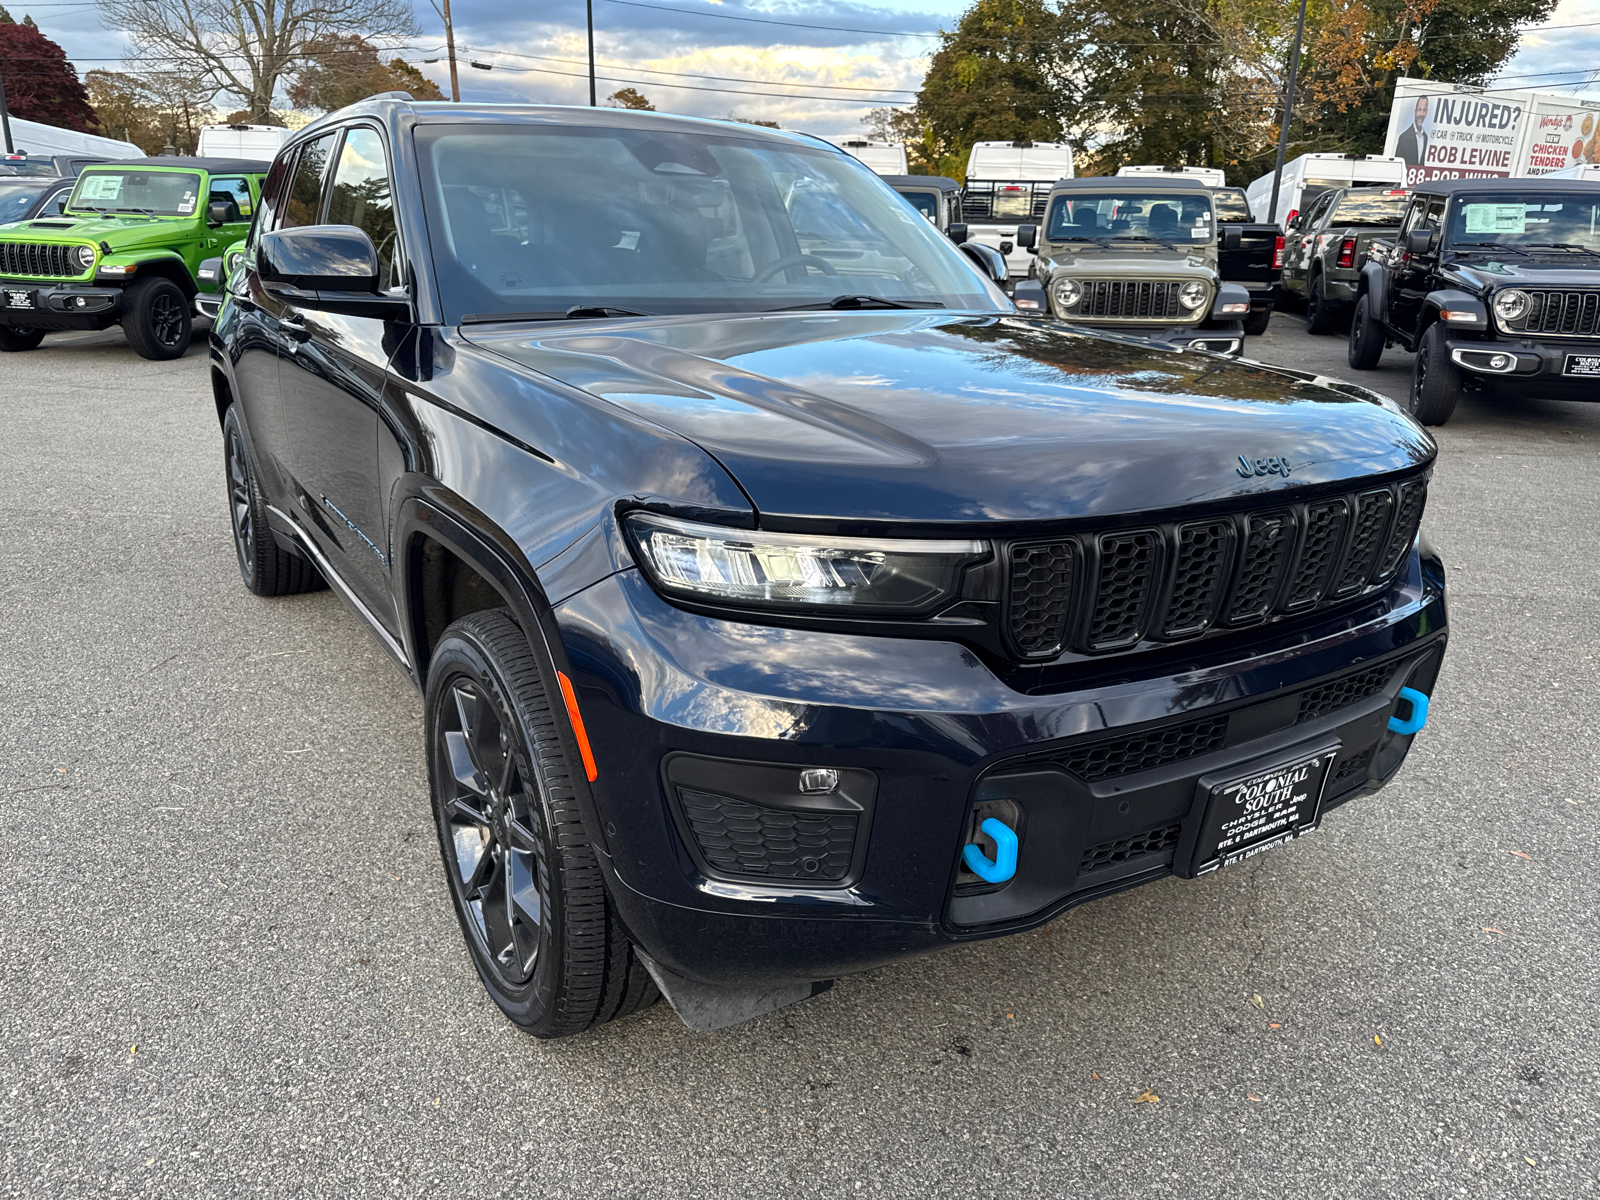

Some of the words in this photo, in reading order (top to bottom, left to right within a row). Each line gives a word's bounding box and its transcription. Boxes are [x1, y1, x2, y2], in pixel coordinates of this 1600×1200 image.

[1433, 97, 1522, 131] INJURED?
[1436, 130, 1448, 140] CAR
[1456, 131, 1474, 142] TRUCK
[1481, 133, 1515, 145] MOTORCYCLE
[1545, 134, 1561, 143] NEW
[1427, 144, 1459, 164] ROB
[1459, 147, 1511, 168] LEVINE
[1532, 143, 1569, 156] CHICKEN
[1530, 155, 1566, 168] TENDERS
[1527, 168, 1540, 176] AND
[1235, 454, 1291, 478] Jeep
[1235, 767, 1309, 804] COLONIAL
[1243, 785, 1294, 815] SOUTH
[1289, 793, 1307, 805] Jeep
[1221, 803, 1283, 830] CHRYSLER
[1273, 805, 1297, 819] RAM
[1217, 838, 1234, 850] RTE.
[1243, 818, 1288, 840] DARTMOUTH,
[1288, 813, 1299, 823] MA
[1226, 817, 1267, 837] DODGE
[1284, 834, 1293, 843] MA
